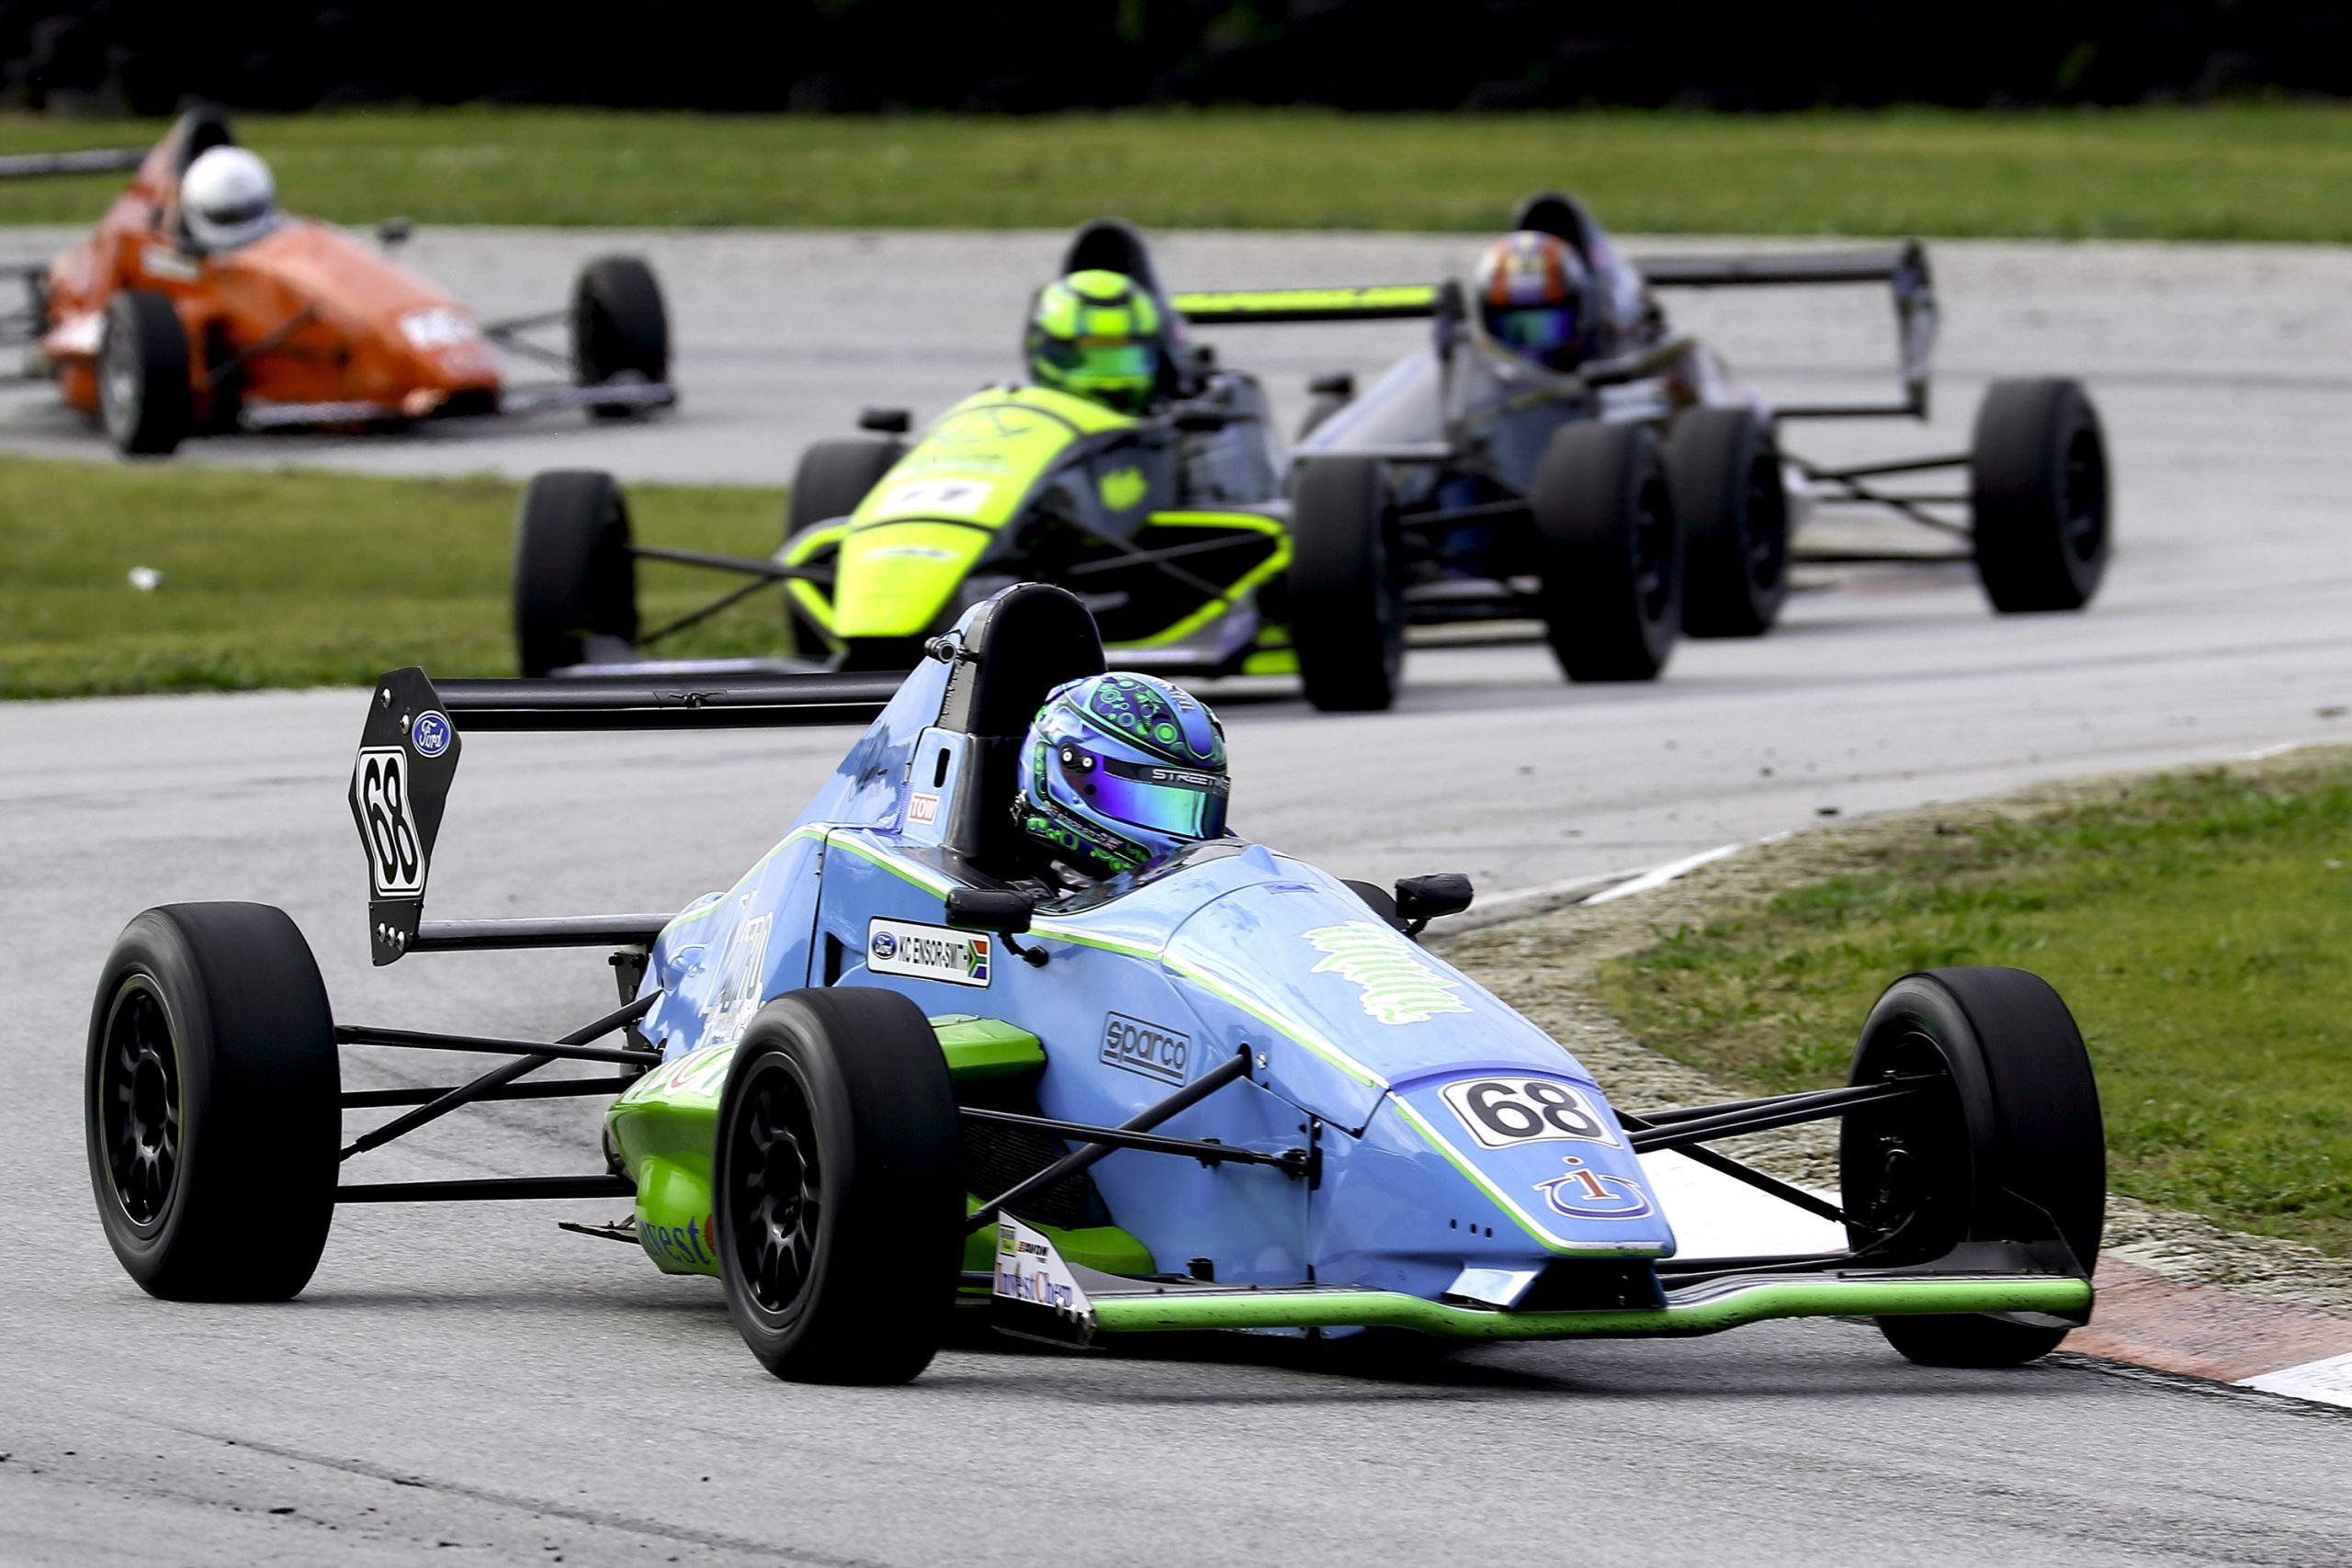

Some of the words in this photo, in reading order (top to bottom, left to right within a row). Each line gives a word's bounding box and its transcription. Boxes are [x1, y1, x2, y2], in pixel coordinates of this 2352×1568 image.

[418, 719, 444, 749] Ford
[363, 757, 418, 886] 68
[1106, 1021, 1186, 1070] sparco
[1467, 1082, 1601, 1138] 68
